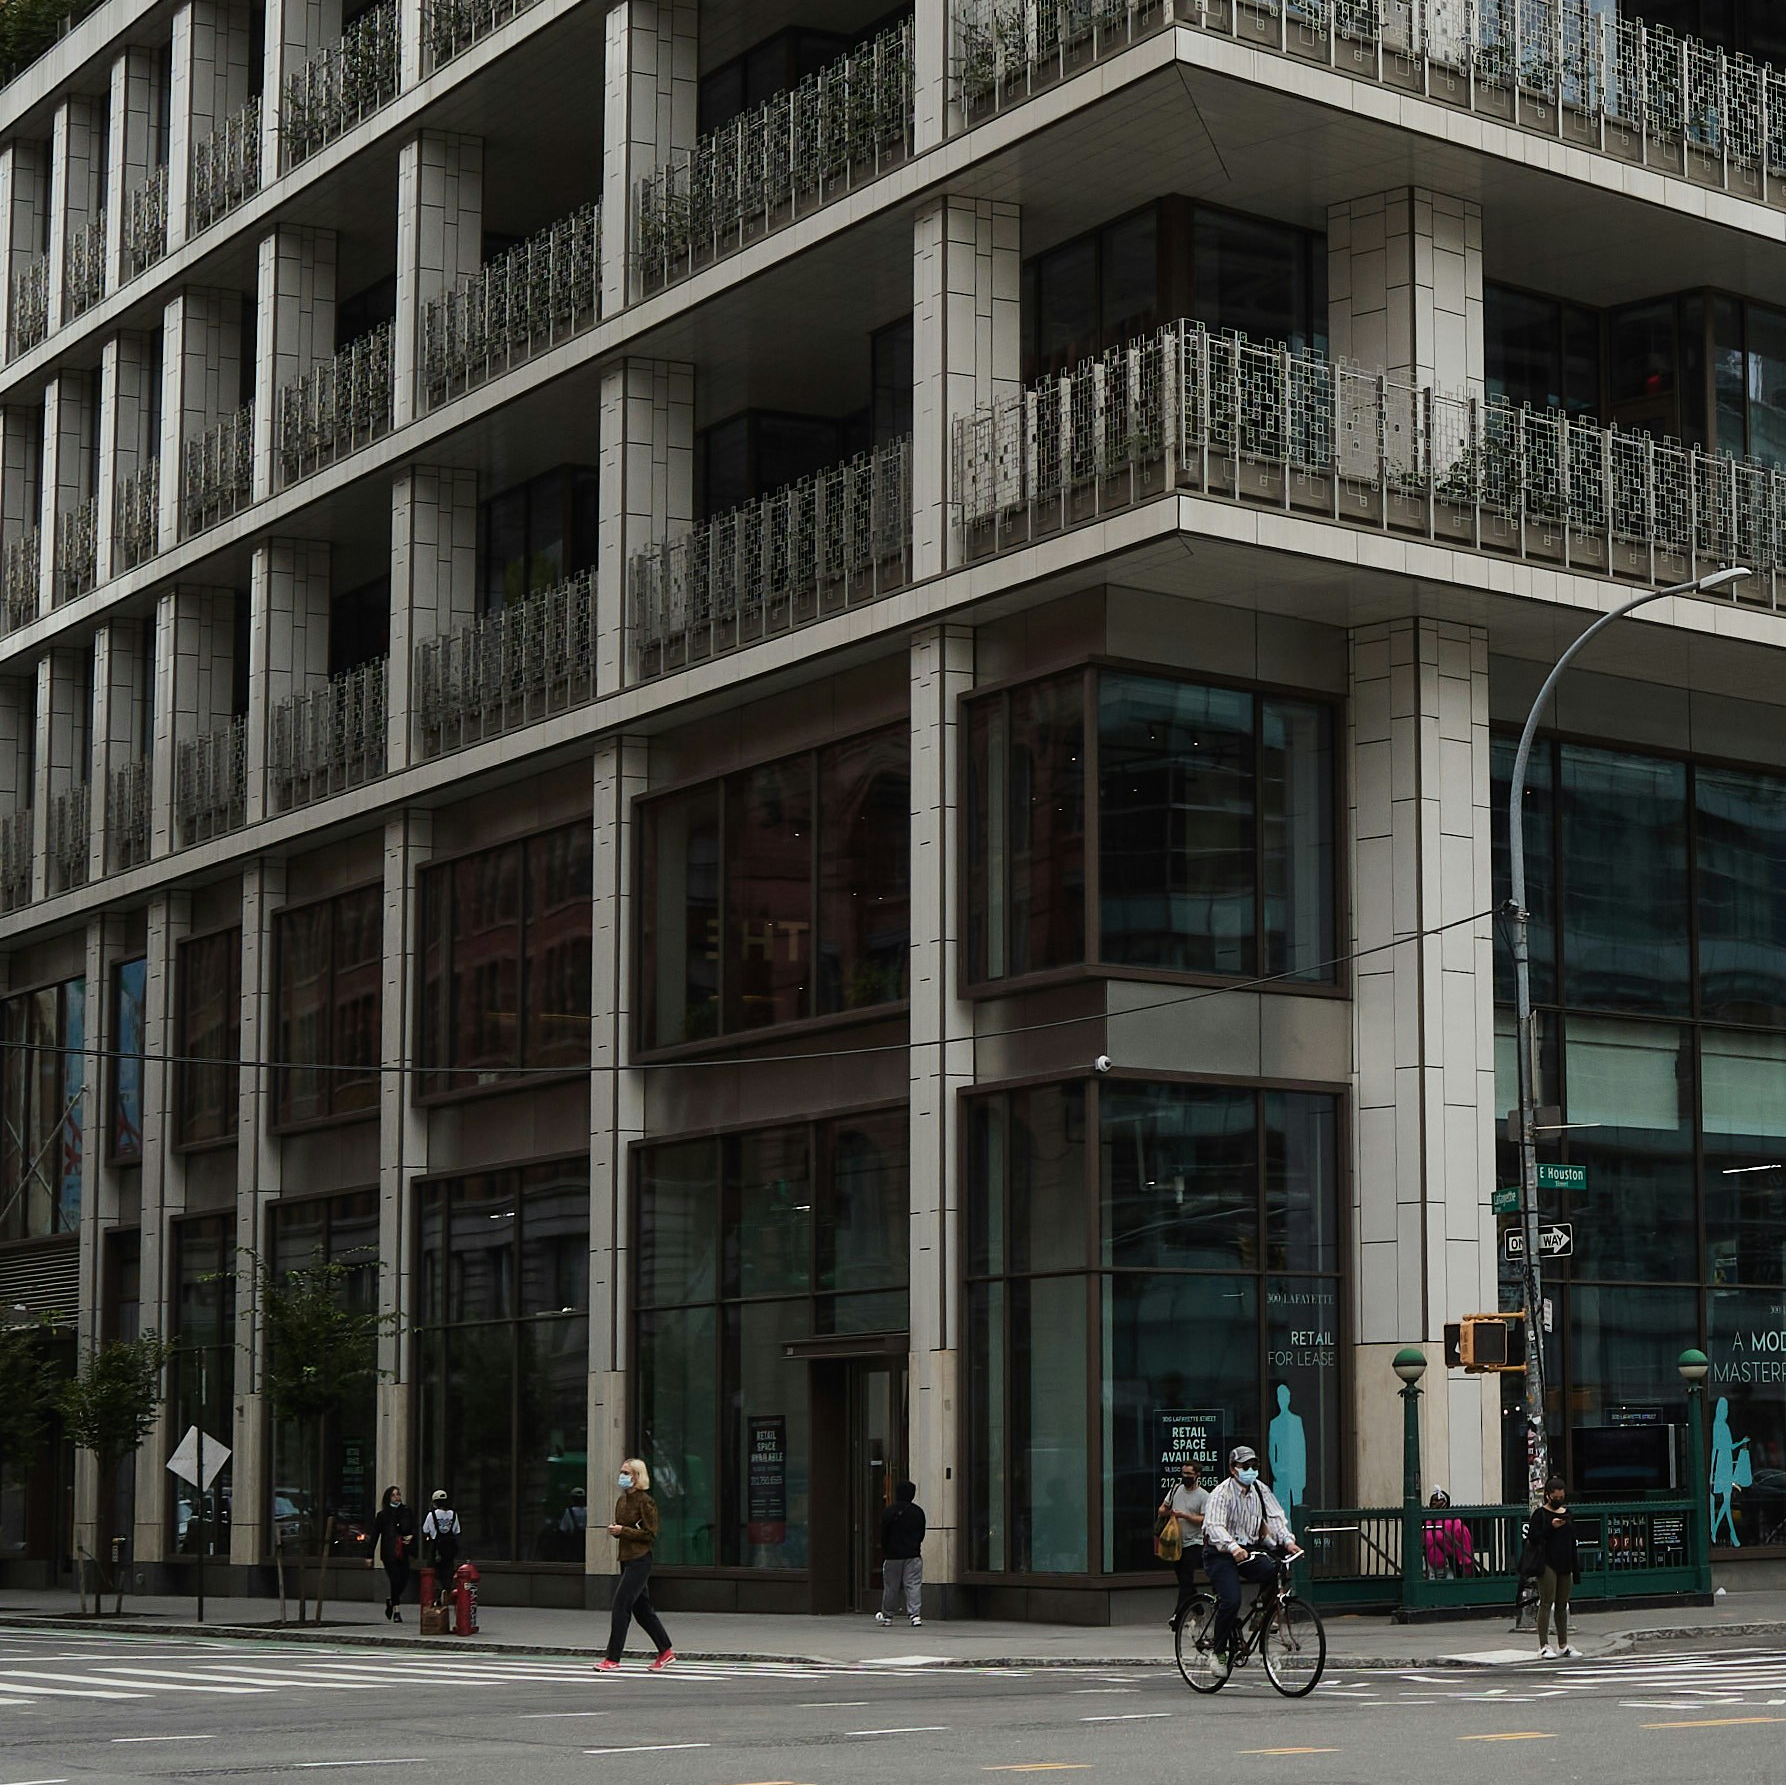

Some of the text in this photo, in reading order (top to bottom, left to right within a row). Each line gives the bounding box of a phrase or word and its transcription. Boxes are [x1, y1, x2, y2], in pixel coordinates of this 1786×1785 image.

[1540, 1167, 1584, 1181] E Houston
[1543, 1234, 1564, 1247] WAY
[1283, 1293, 1335, 1304] LAFAYETTE
[1291, 1330, 1335, 1346] RETAIL
[1732, 1331, 1744, 1351] A
[1268, 1351, 1335, 1366] FOR LEASE
[1172, 1426, 1207, 1437] RETAIL
[1173, 1438, 1206, 1450] SPACE
